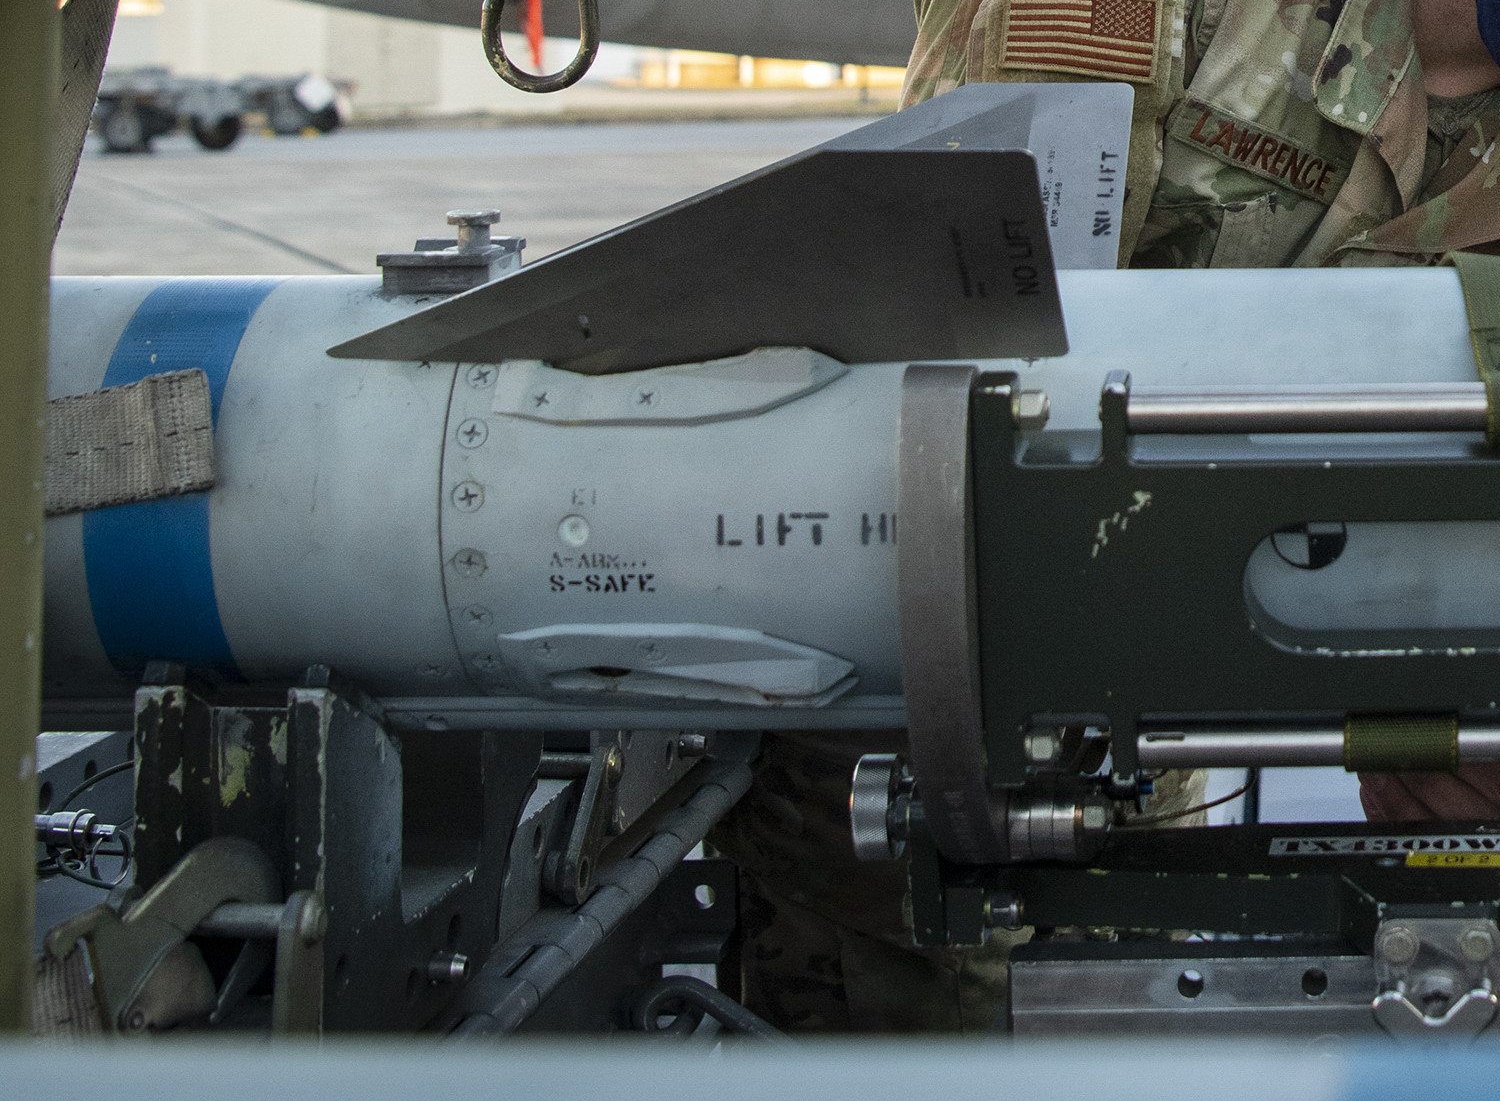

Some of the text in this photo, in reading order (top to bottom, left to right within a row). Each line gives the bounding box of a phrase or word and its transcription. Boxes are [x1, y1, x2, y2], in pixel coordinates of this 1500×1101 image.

[1188, 108, 1338, 198] LAWRENCE
[1091, 150, 1120, 237] NO LIFT
[1001, 217, 1041, 296] NO LIFT
[717, 512, 831, 546] LIFT
[549, 574, 657, 593] S-SAFE
